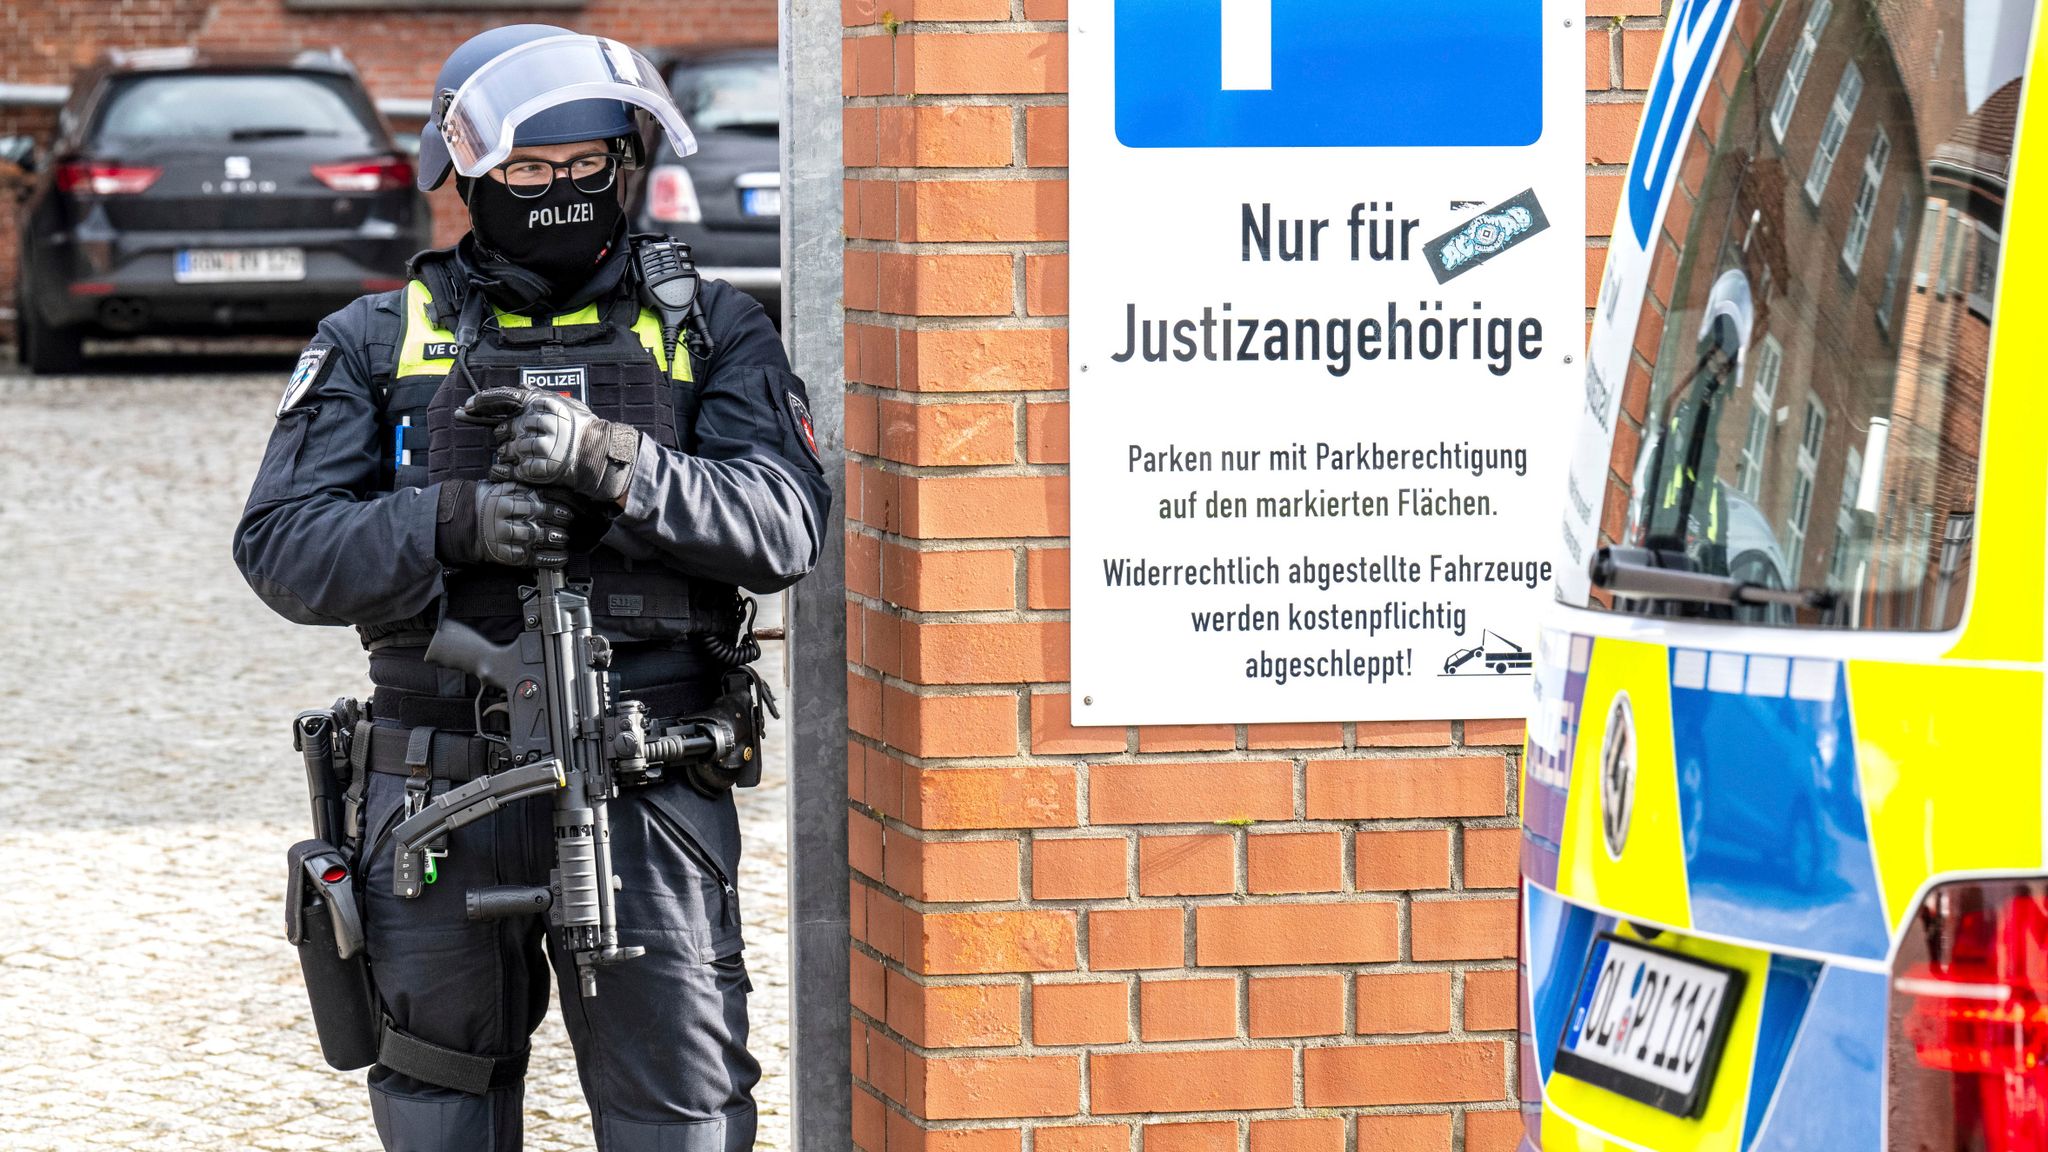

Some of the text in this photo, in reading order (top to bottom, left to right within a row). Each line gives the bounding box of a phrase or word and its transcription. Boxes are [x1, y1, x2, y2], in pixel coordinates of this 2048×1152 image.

[528, 202, 594, 229] POLIZEI
[1242, 202, 1329, 262] Nur
[1347, 201, 1420, 262] für
[428, 344, 446, 355] VE
[1110, 300, 1543, 377] Justizangehörige
[527, 374, 580, 387] POLIZEI
[1129, 441, 1527, 477] Parken nur mit Parkberechtigung
[1159, 487, 1497, 519] auf den markierten Flächen.
[1103, 554, 1552, 591] Widerrechtlich abgestellte Fahrzeuge
[1191, 601, 1466, 637] werden kostenpflichtig
[1246, 648, 1412, 686] abgeschleppt!
[1585, 959, 1717, 1075] OL PI 116
